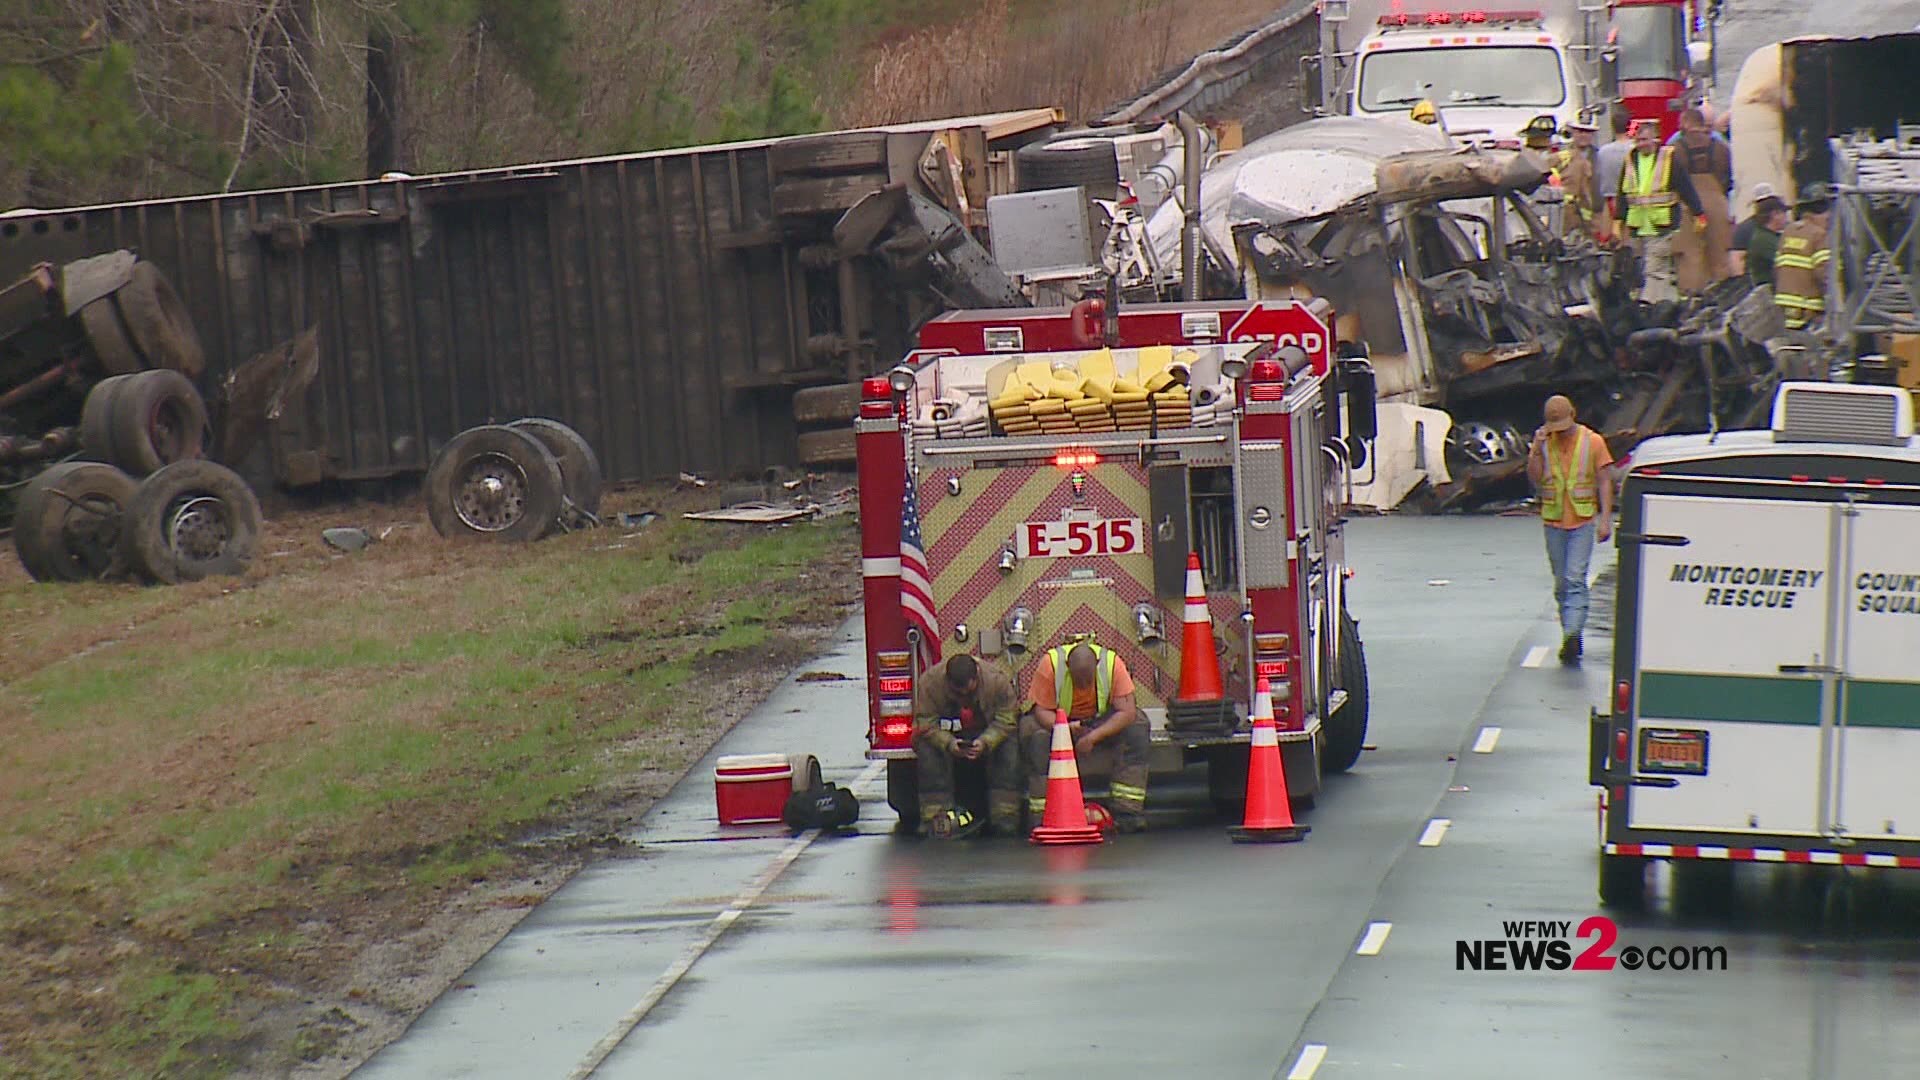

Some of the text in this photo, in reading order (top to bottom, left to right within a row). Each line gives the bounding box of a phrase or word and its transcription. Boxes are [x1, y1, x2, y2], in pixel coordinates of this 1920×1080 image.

[1027, 520, 1135, 557] E-515
[1669, 564, 1920, 592] MONTGOMERY COUN
[1704, 588, 1920, 614] RESCUE SQUA
